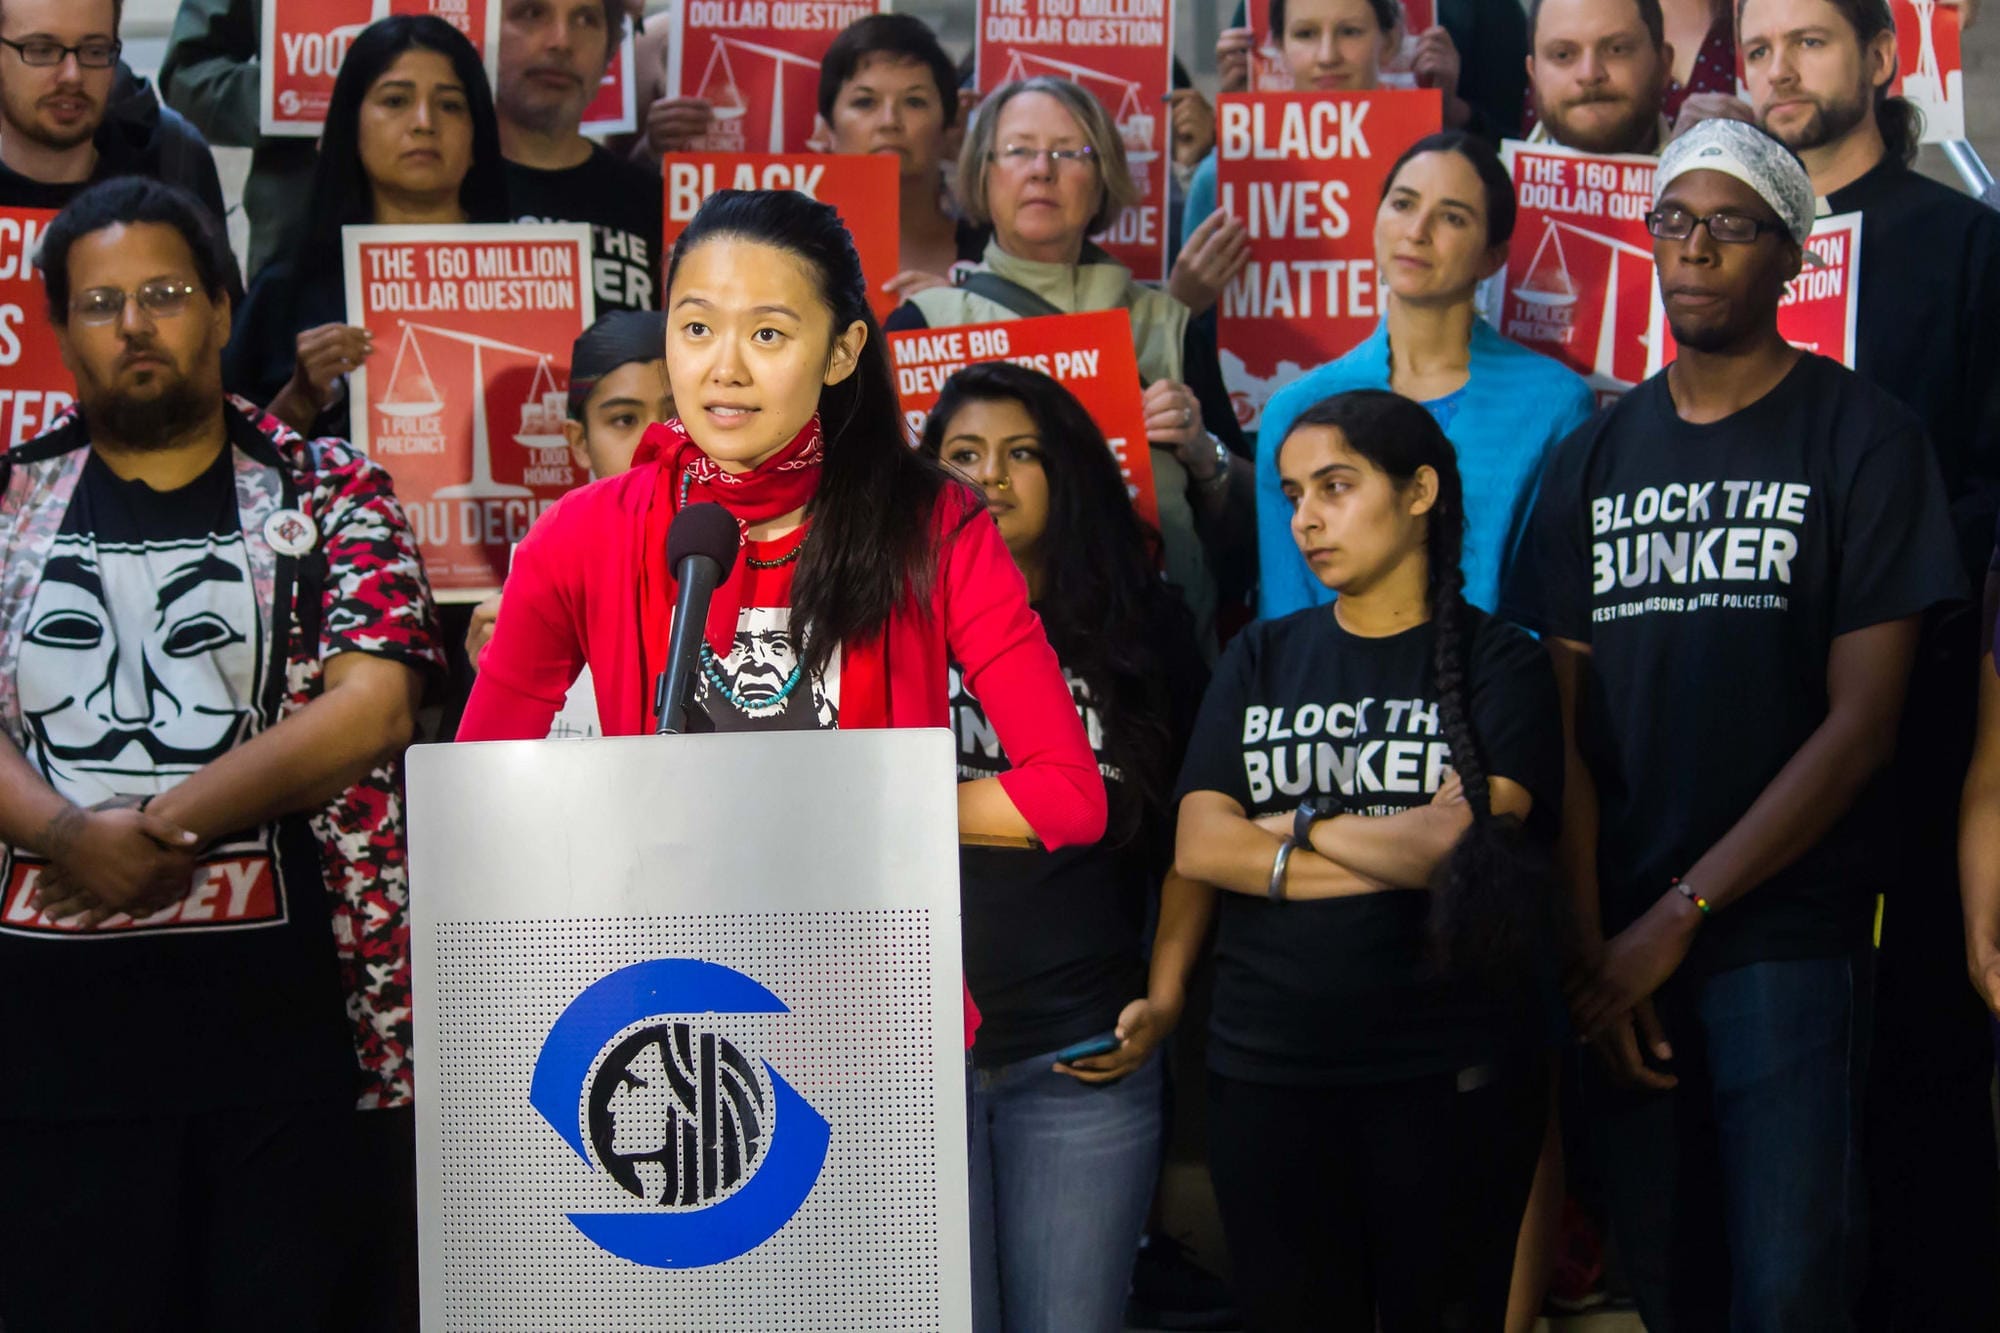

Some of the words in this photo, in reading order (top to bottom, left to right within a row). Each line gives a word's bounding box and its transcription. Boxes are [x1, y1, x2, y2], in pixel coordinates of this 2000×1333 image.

[690, 2, 767, 28] DOLLAR
[986, 16, 1063, 43] DOLLAR
[1067, 19, 1163, 46] QUESTION
[1221, 101, 1371, 160] BLACK
[1520, 156, 1566, 186] THE
[1575, 162, 1617, 191] 160
[1222, 180, 1351, 239] LIVES
[1519, 183, 1603, 216] DOLLAR
[594, 224, 649, 267] THE
[368, 248, 414, 278] THE
[425, 248, 469, 278] 160
[476, 246, 572, 278] MILLION
[370, 281, 459, 311] DOLLAR
[464, 279, 575, 310] QUESTION
[893, 333, 966, 366] MAKE
[969, 328, 1010, 358] BIG
[1054, 349, 1099, 380] PAY
[392, 416, 441, 435] POLICE
[376, 435, 446, 455] PRECINCT
[523, 467, 574, 486] HOMES
[1592, 481, 1716, 536] BLOCK
[1722, 480, 1811, 525] THE
[1593, 527, 1799, 595] BUNKER
[1700, 593, 1719, 607] THE
[1722, 593, 1762, 609] POLICE
[1242, 697, 1376, 745] BLOCK
[1383, 698, 1445, 736] TH
